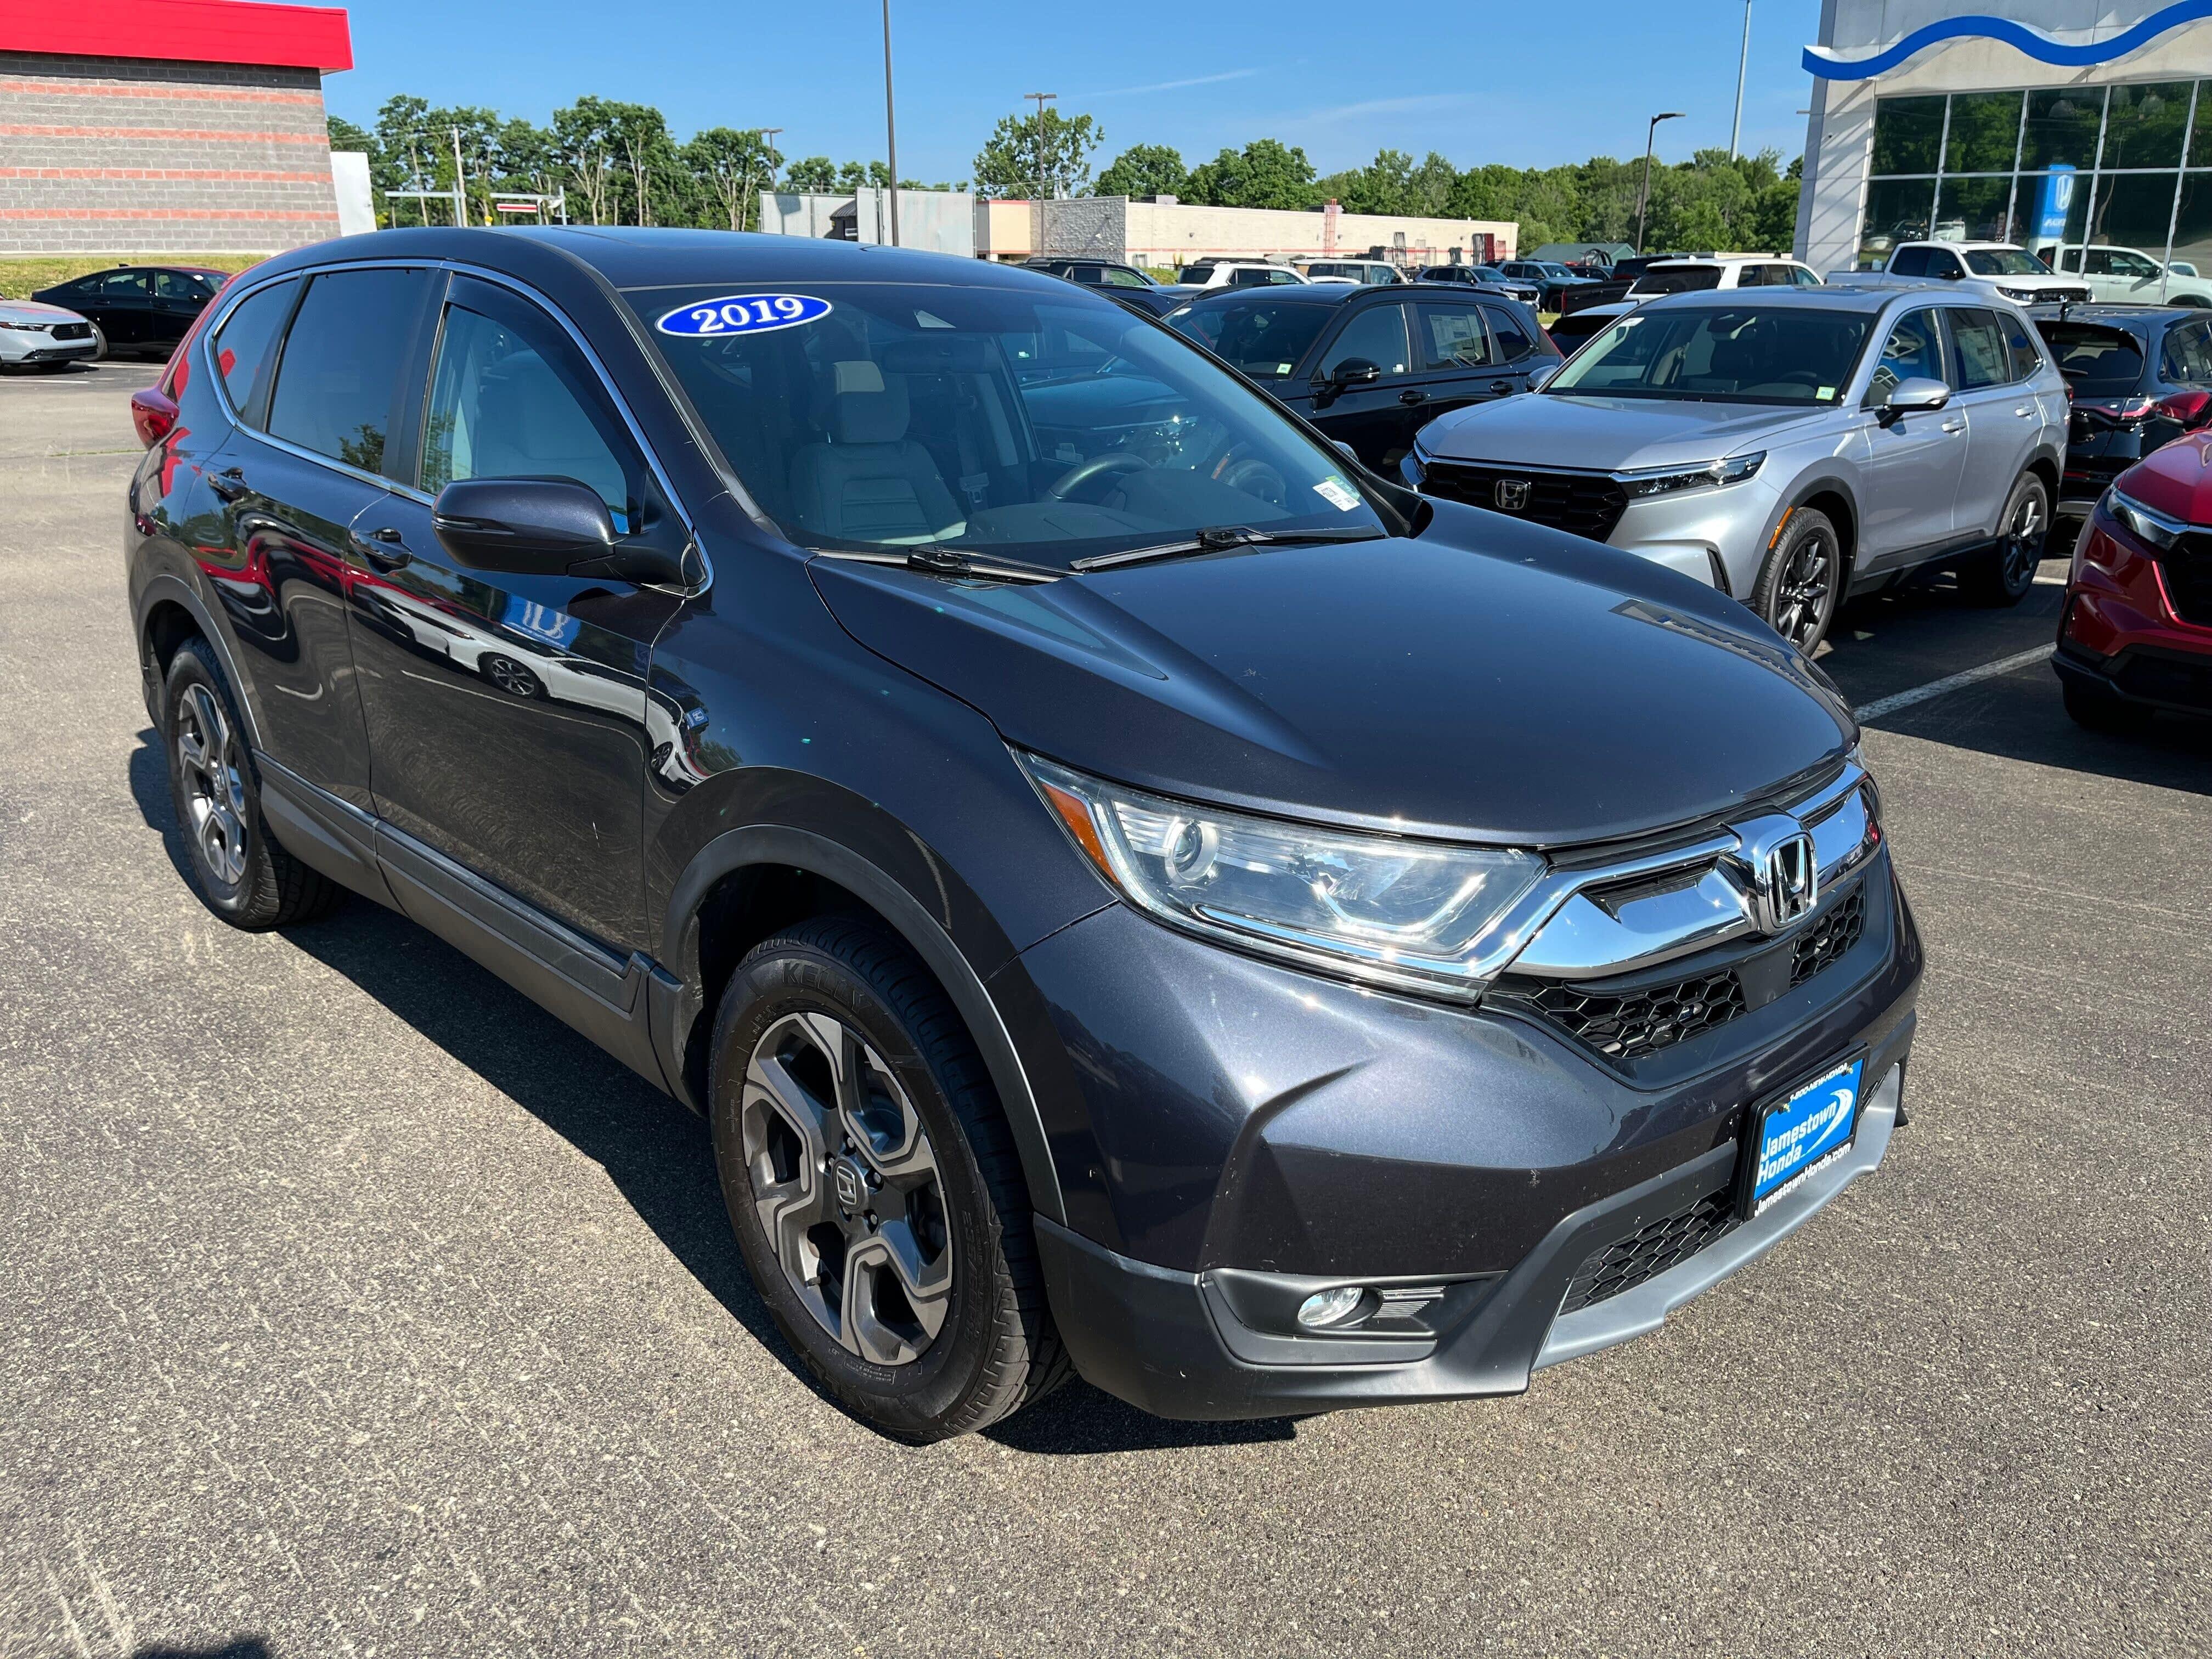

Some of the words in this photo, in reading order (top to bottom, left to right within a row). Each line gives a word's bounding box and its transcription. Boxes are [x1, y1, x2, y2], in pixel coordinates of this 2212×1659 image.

[691, 297, 804, 333] 2019
[1761, 1101, 1837, 1161] Jamestown
[1754, 1142, 1851, 1217] JamestownHonda.com
[1756, 1144, 1803, 1187] Honda
